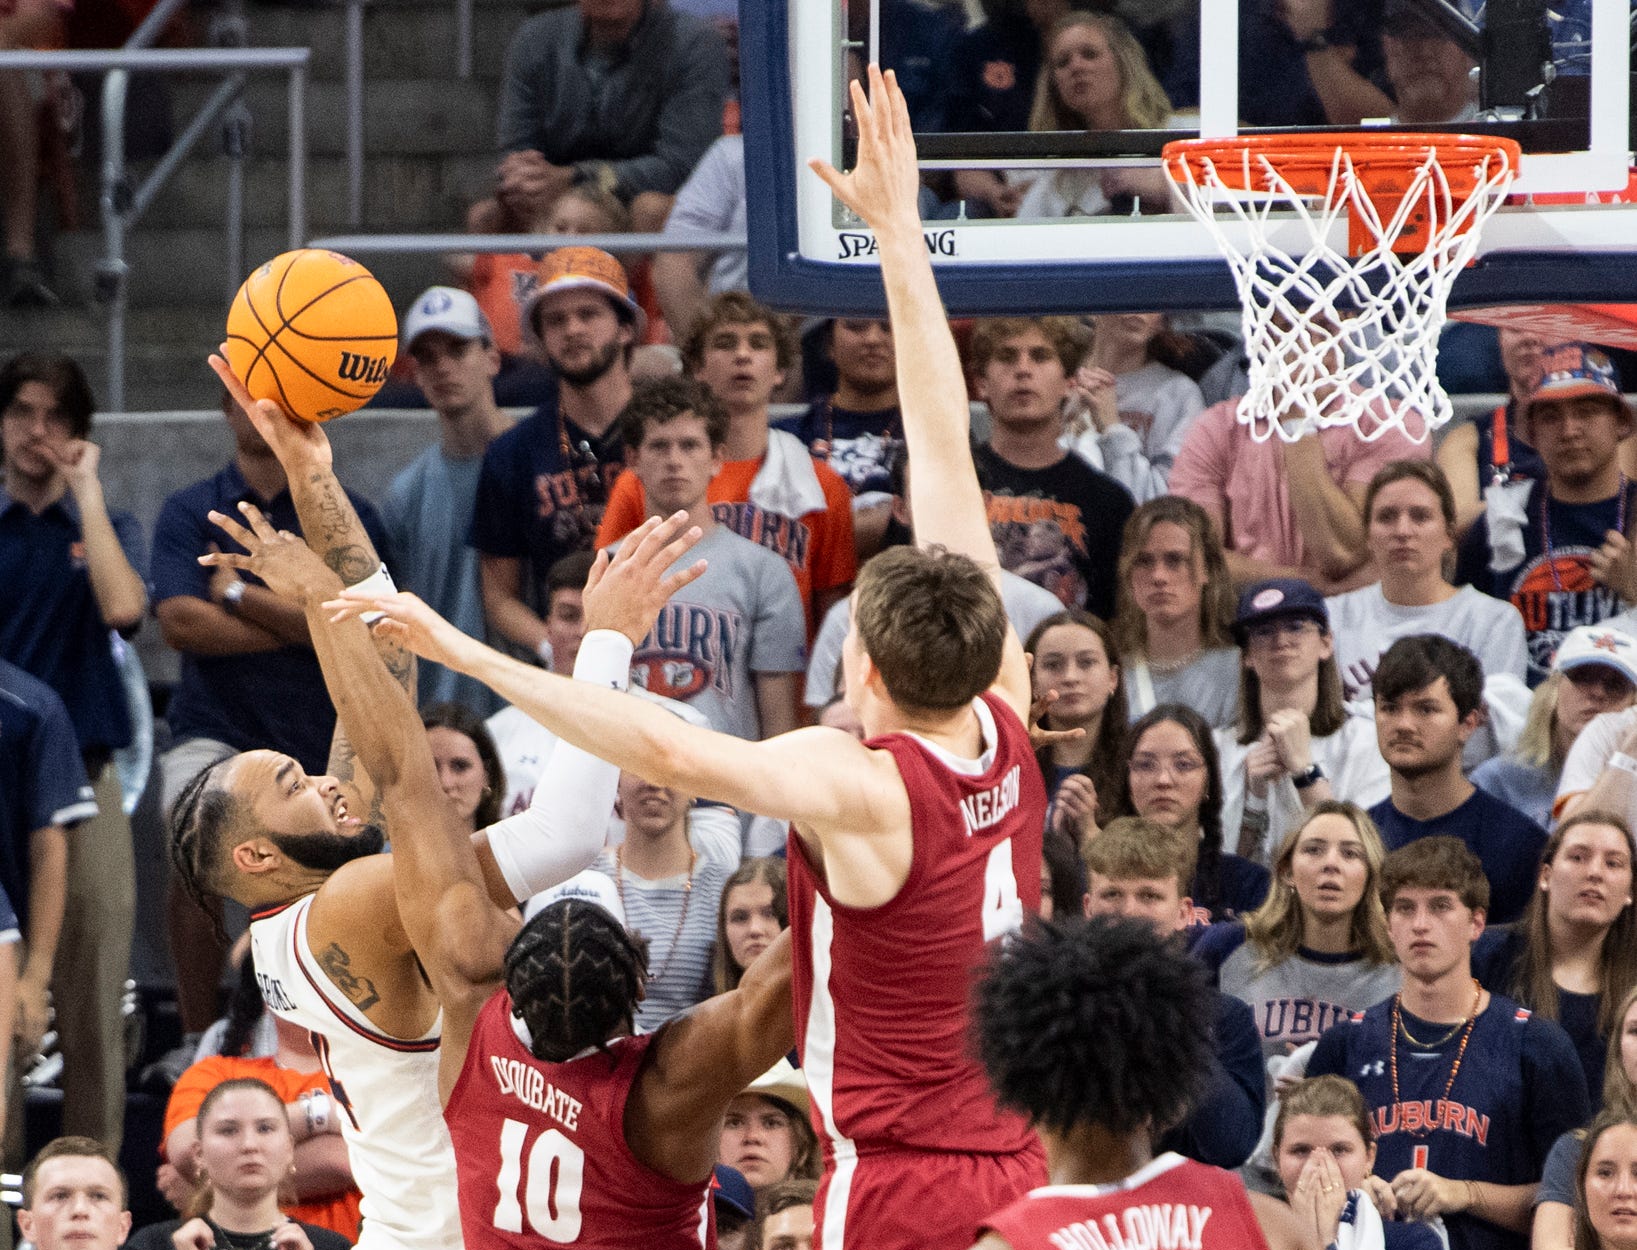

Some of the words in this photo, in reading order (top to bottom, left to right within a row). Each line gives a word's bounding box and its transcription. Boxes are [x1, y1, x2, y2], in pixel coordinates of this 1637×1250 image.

[838, 229, 956, 260] SPANG
[338, 350, 392, 384] Wils
[981, 836, 1024, 943] 4
[493, 1117, 585, 1244] 10
